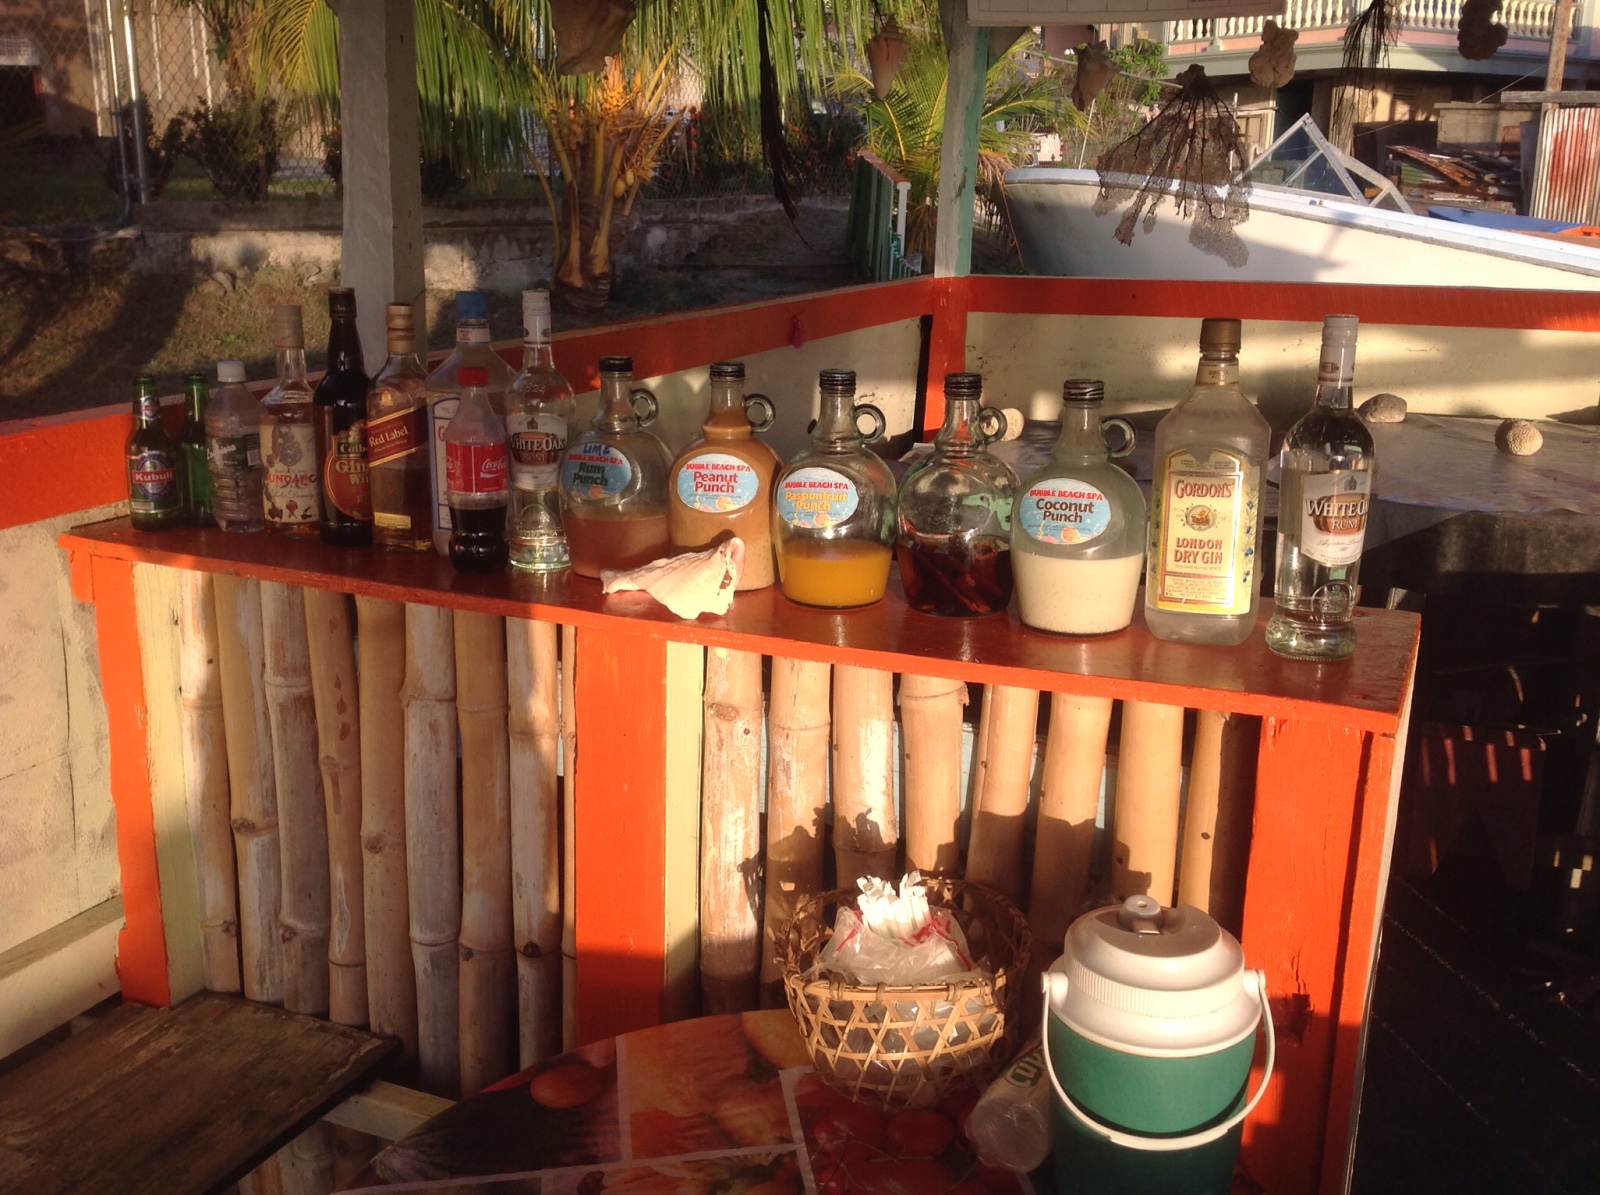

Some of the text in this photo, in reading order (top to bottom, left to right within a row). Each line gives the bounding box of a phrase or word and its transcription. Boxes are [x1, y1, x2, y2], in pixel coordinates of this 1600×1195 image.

[368, 434, 385, 447] Red
[385, 425, 408, 441] Label
[543, 436, 566, 451] OAK
[579, 462, 606, 474] Rum
[135, 472, 173, 482] Kubuli
[573, 473, 608, 487] Punch
[693, 471, 738, 483] Peanut
[695, 481, 735, 494] Punch
[1174, 480, 1232, 499] GORDON'S
[785, 490, 847, 502] Passionfruit
[1058, 490, 1085, 499] BEACH
[1086, 492, 1103, 501] SPA
[796, 501, 831, 511] Punch
[1036, 498, 1095, 514] Coconut
[1305, 499, 1356, 517] WHITE
[1043, 510, 1083, 523] Punch
[1332, 519, 1358, 530] RUM
[1176, 537, 1223, 550] LONDON
[1174, 549, 1223, 565] DRY GIN
